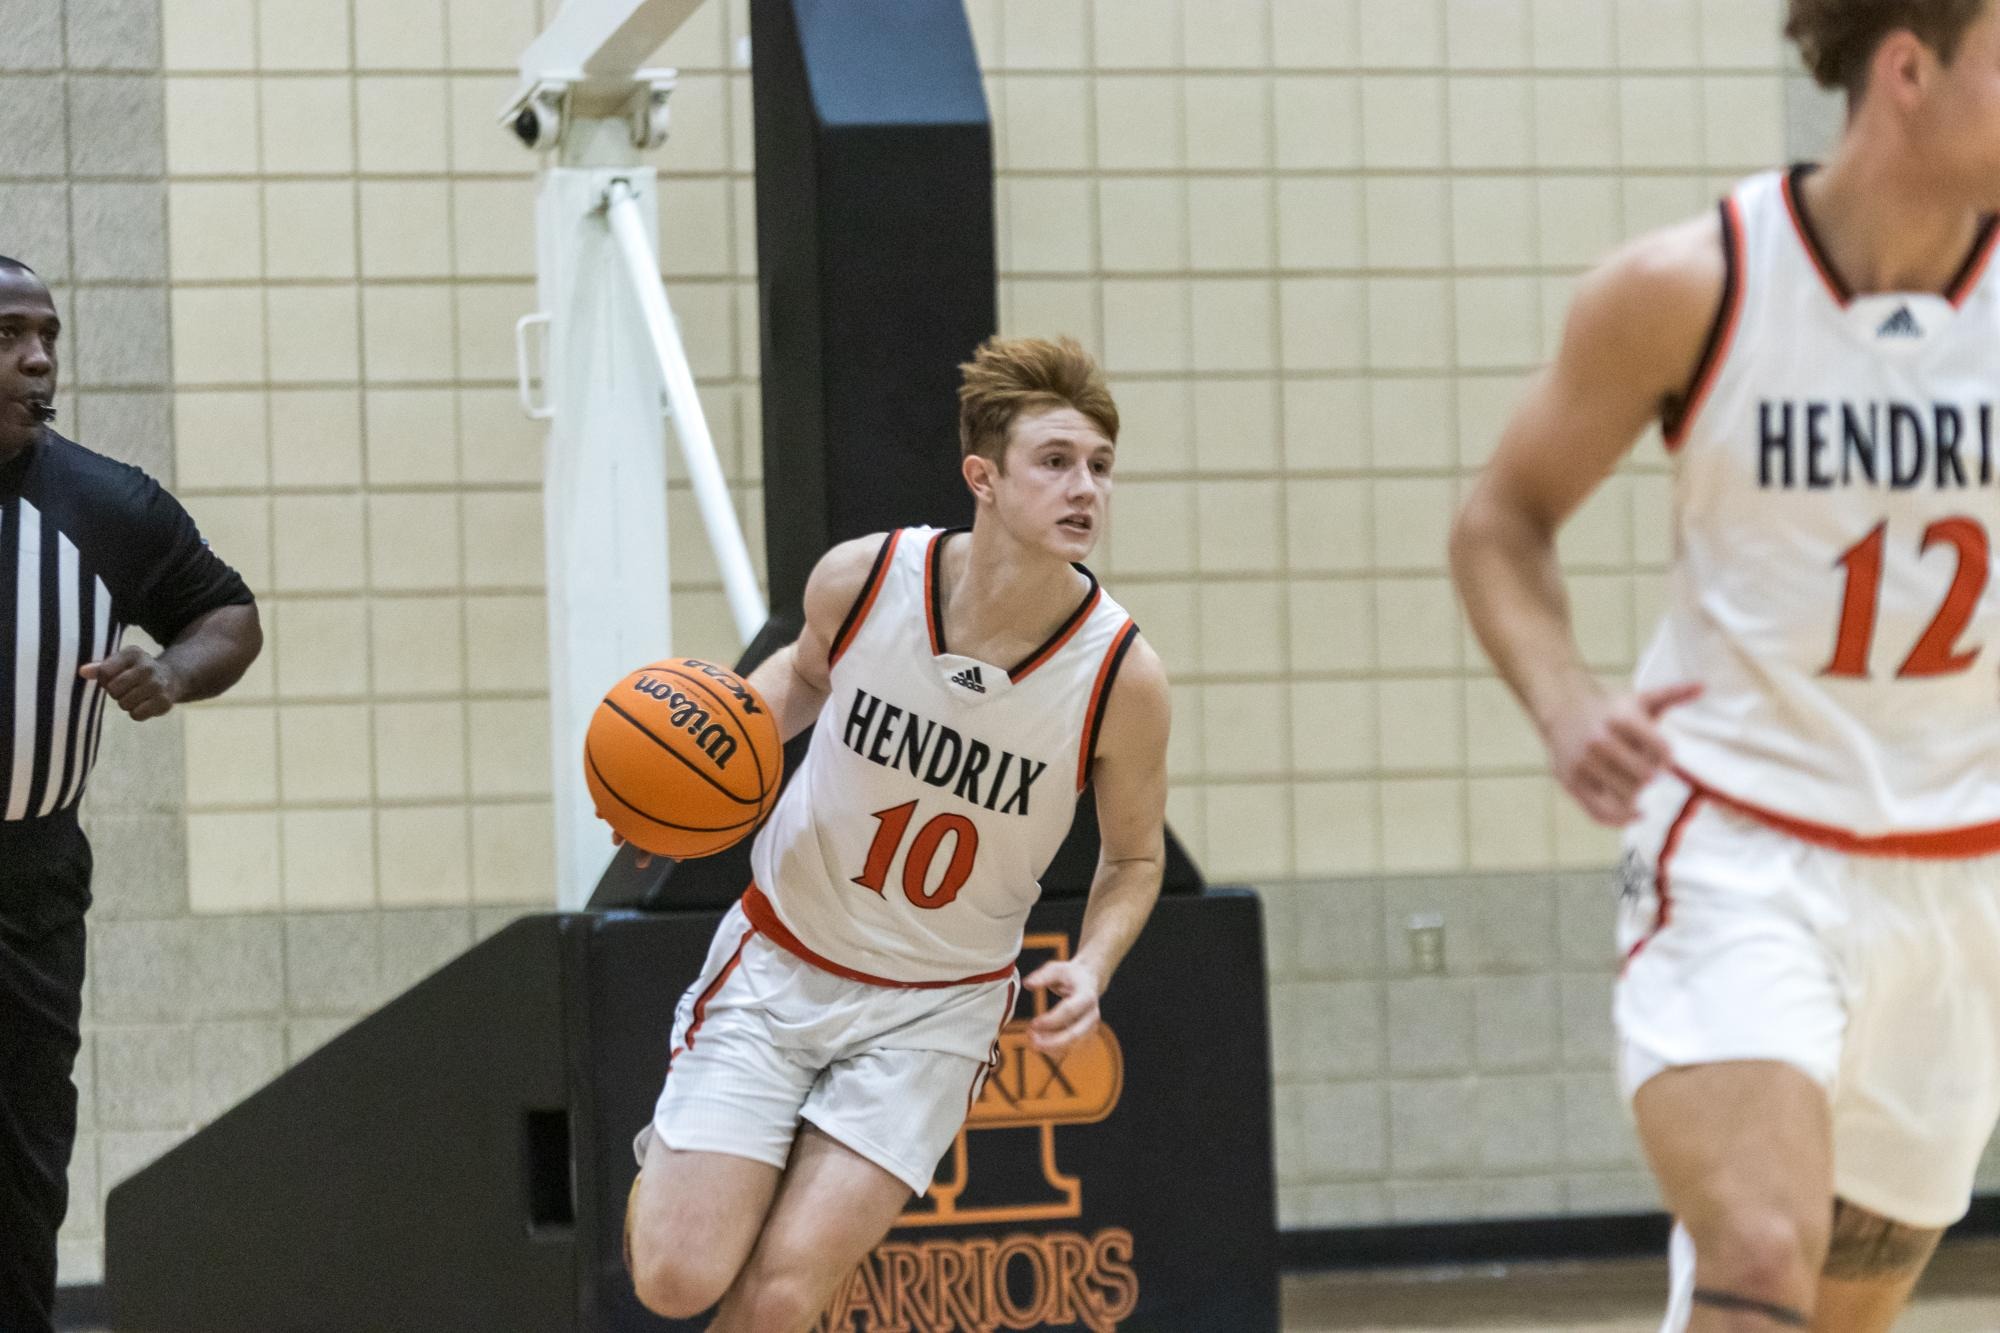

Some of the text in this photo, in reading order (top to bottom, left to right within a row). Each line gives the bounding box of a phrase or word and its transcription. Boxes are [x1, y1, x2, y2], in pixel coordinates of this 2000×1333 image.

[1758, 402, 2000, 490] HENDRI
[1818, 514, 1990, 680] 12
[634, 675, 738, 771] Wilson
[683, 660, 762, 714] NCAA
[952, 675, 986, 694] adidas
[843, 688, 1047, 815] HENDRIX
[850, 799, 979, 909] 10
[816, 1227, 1139, 1333] ARRIORS
